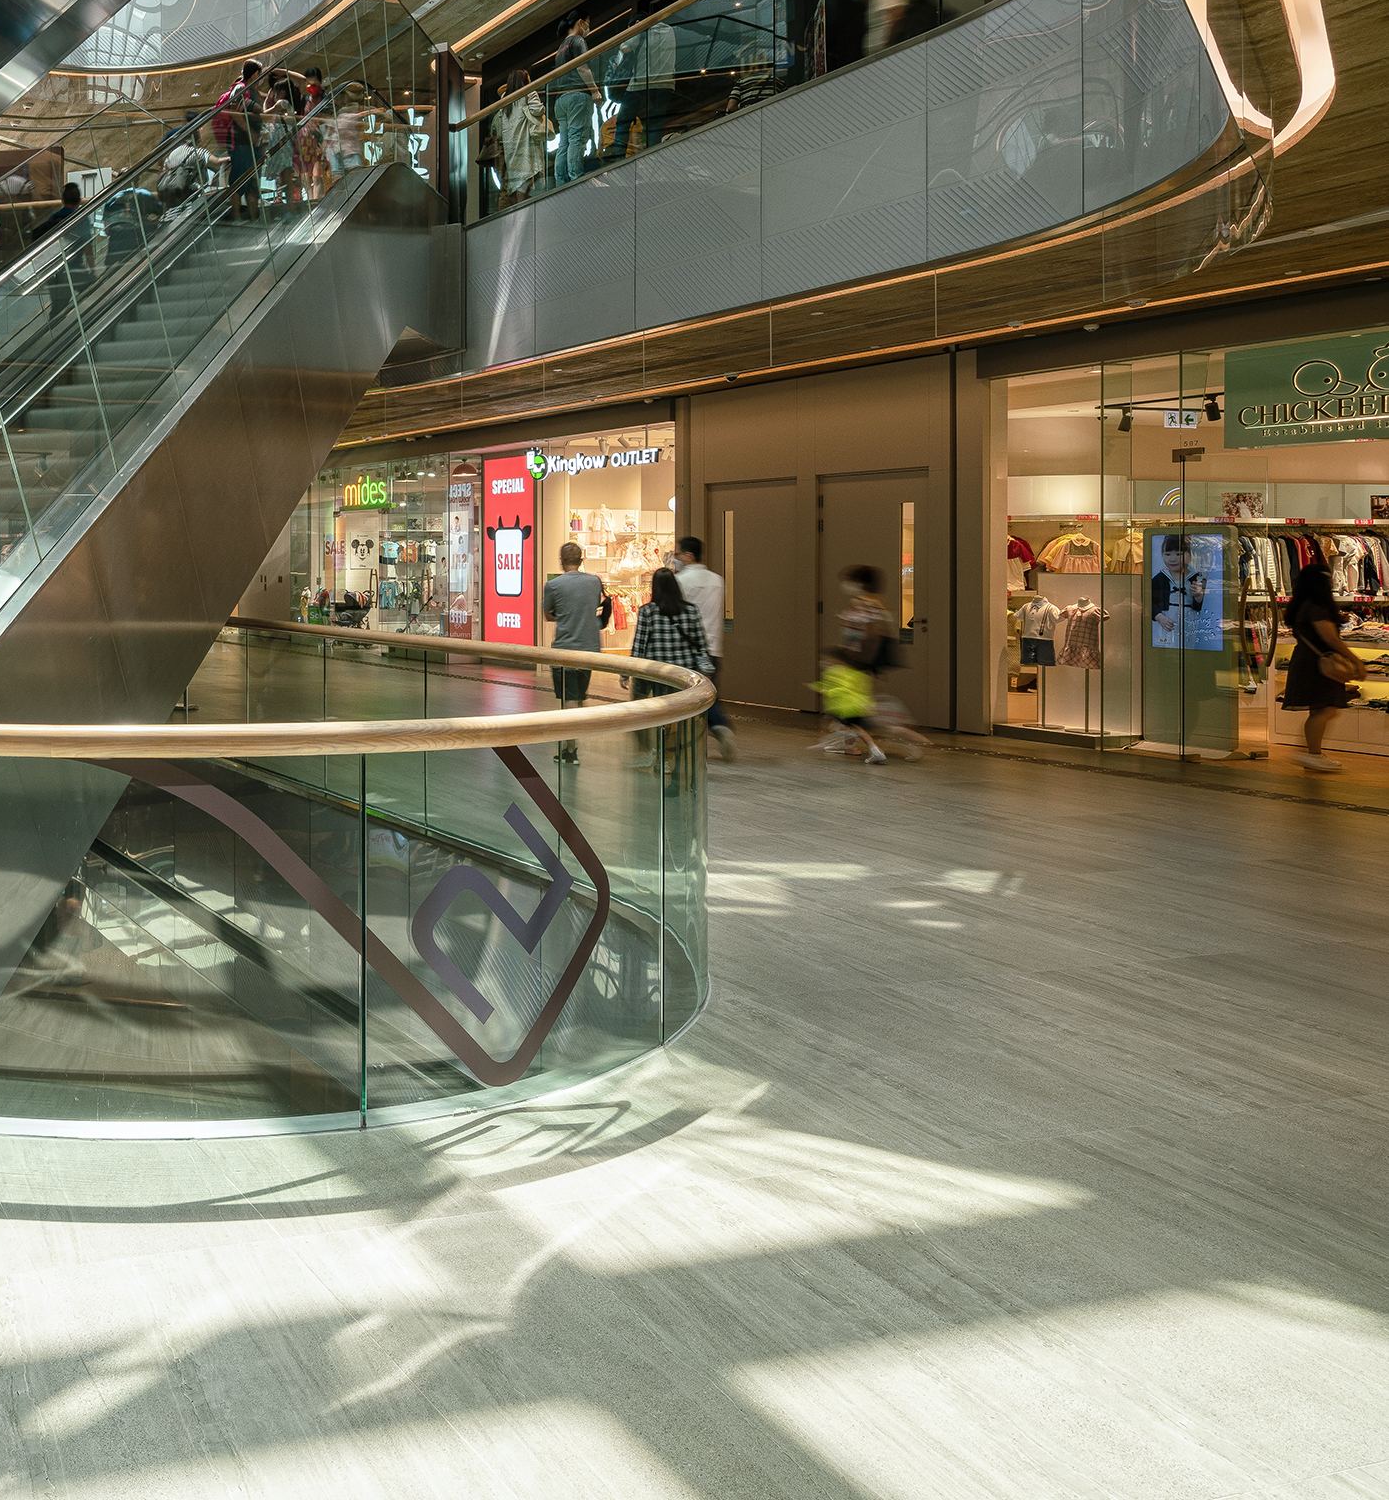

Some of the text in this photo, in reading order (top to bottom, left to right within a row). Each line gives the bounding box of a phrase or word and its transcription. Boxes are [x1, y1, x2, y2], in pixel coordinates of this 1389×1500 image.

[1261, 420, 1366, 438] Established
[610, 448, 659, 468] OUTLET
[491, 478, 525, 495] SPECIAL
[497, 553, 521, 571] SALE
[496, 612, 521, 629] OFFER
